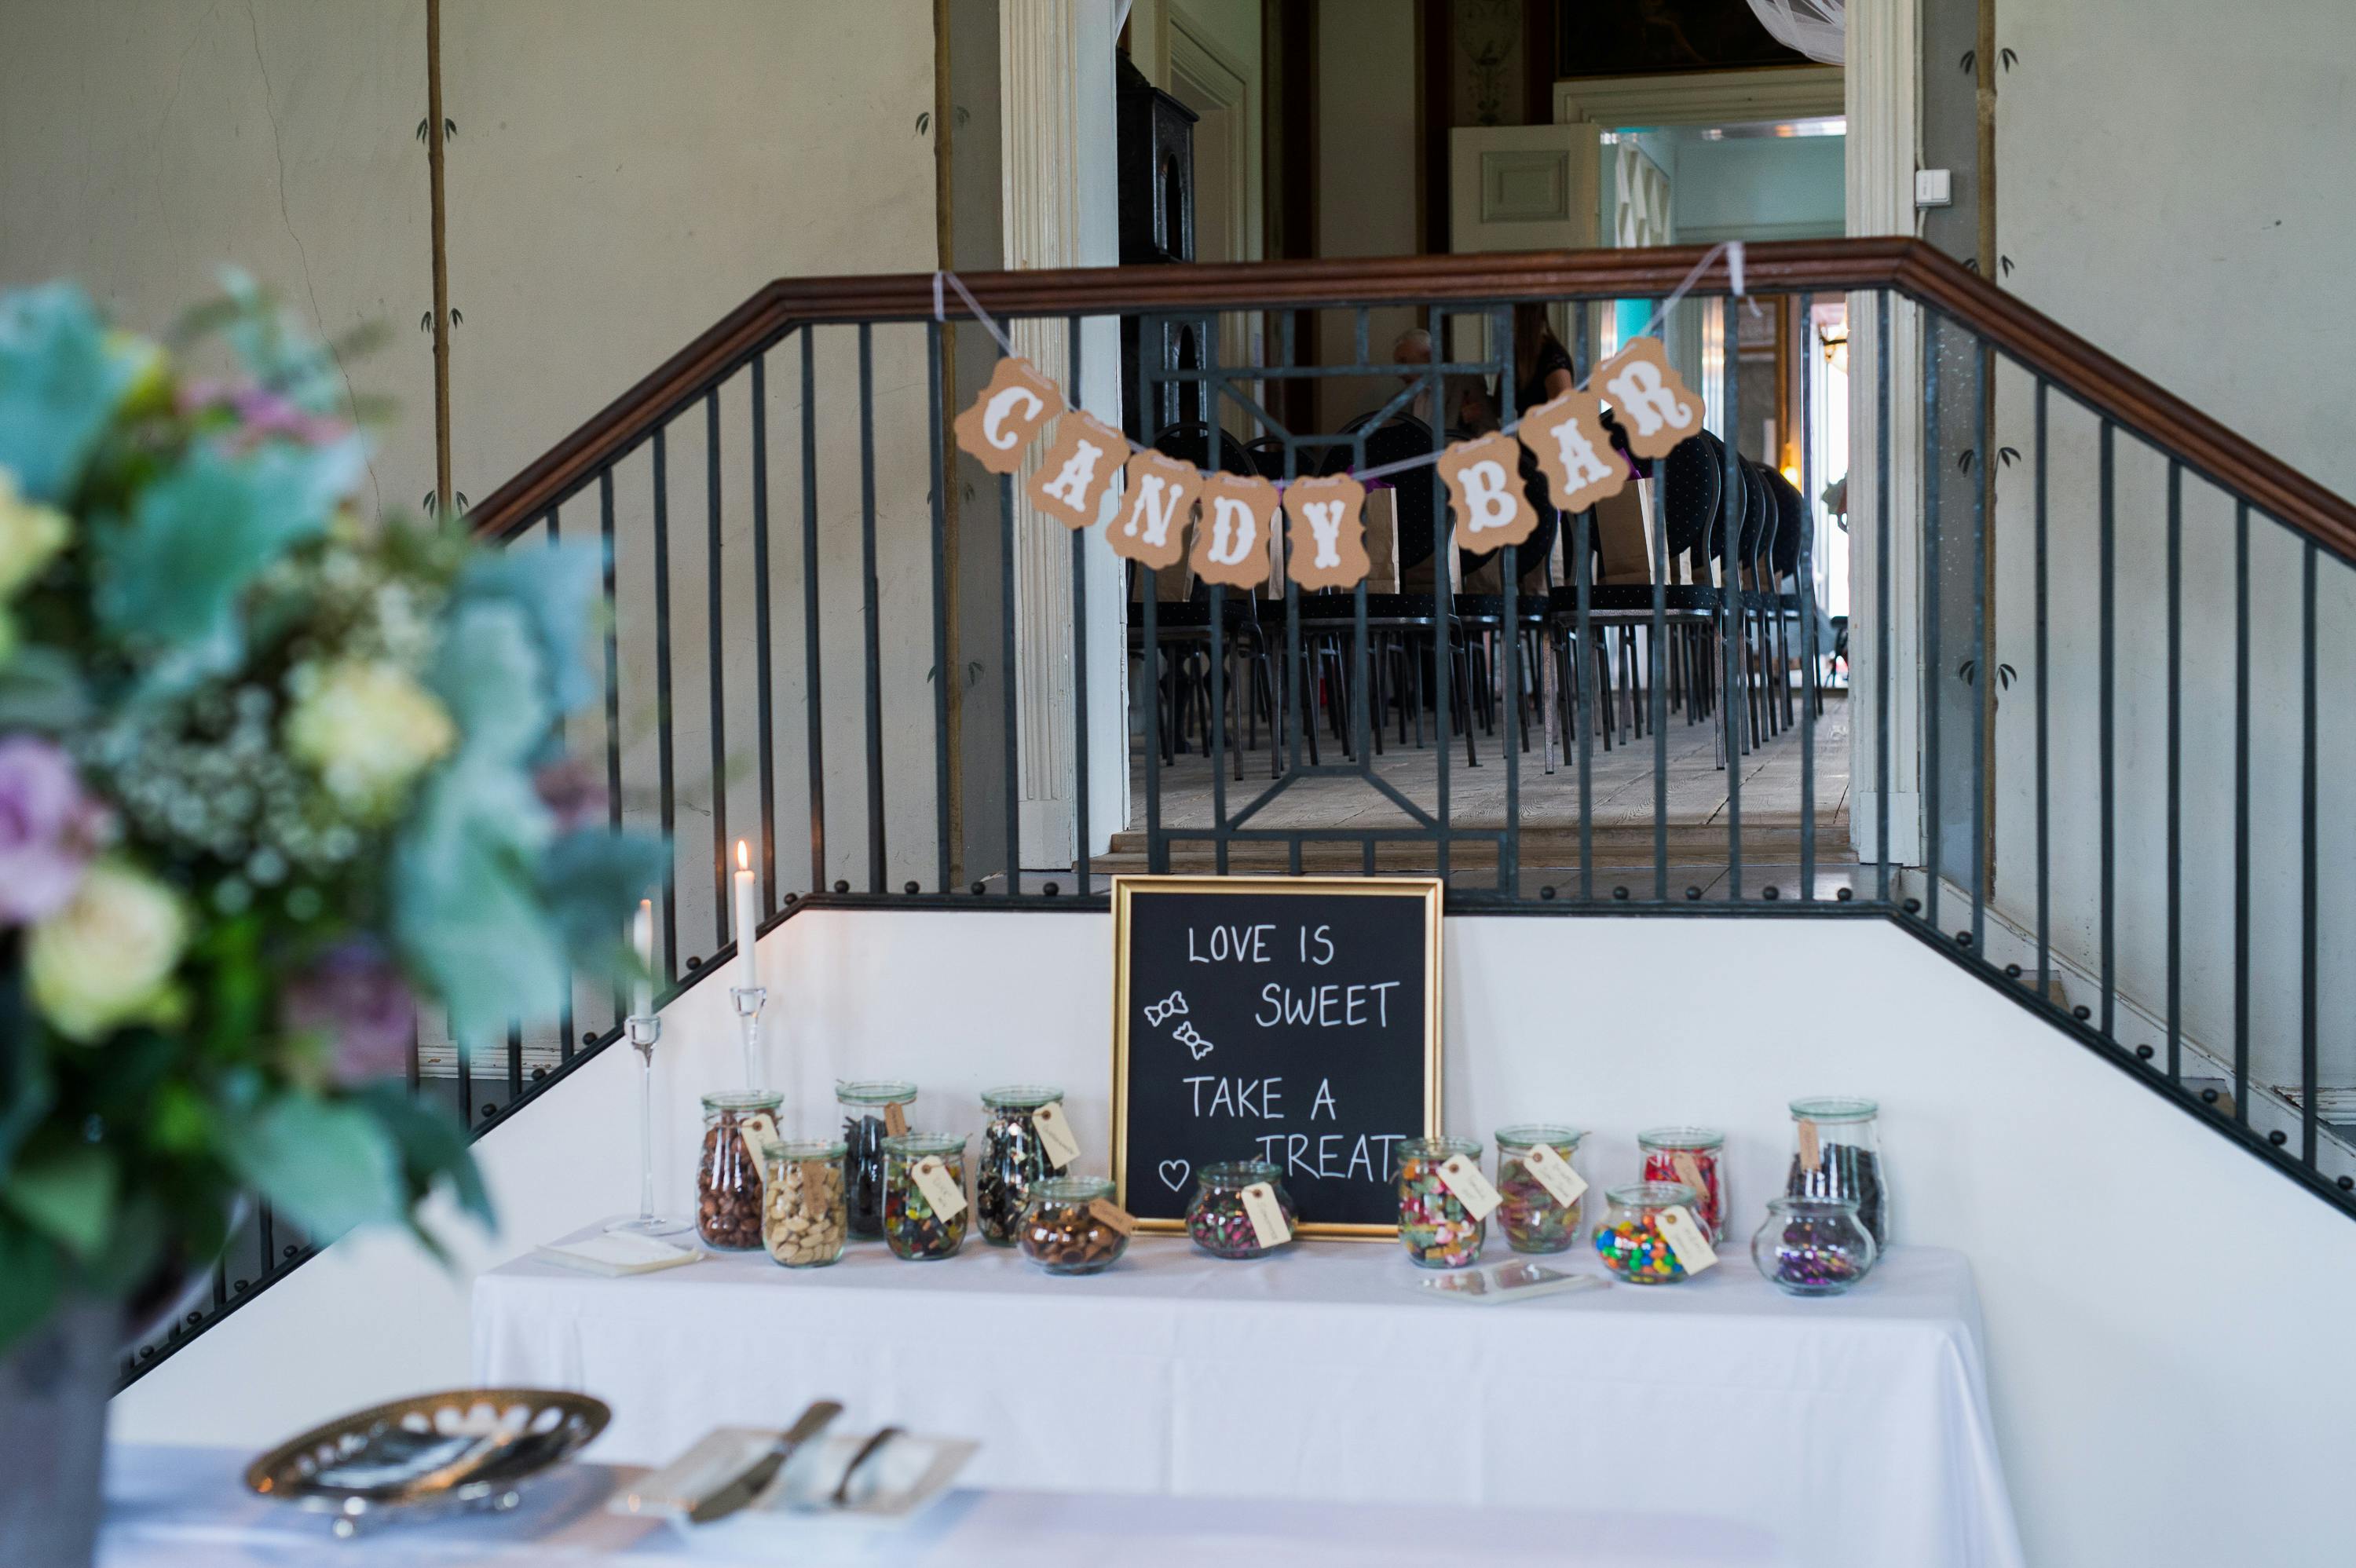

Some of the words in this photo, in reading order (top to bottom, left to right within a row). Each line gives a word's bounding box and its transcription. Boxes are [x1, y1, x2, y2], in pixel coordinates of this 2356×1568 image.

[983, 386, 1346, 569] CANDY
[1457, 360, 1693, 532] BAR
[1188, 925, 1277, 964] LOVE
[1300, 925, 1335, 966] IS
[1256, 981, 1401, 1029] SWEET
[1183, 1076, 1285, 1120] TAKE
[1310, 1078, 1337, 1121] A
[1255, 1134, 1407, 1184] TREAT
